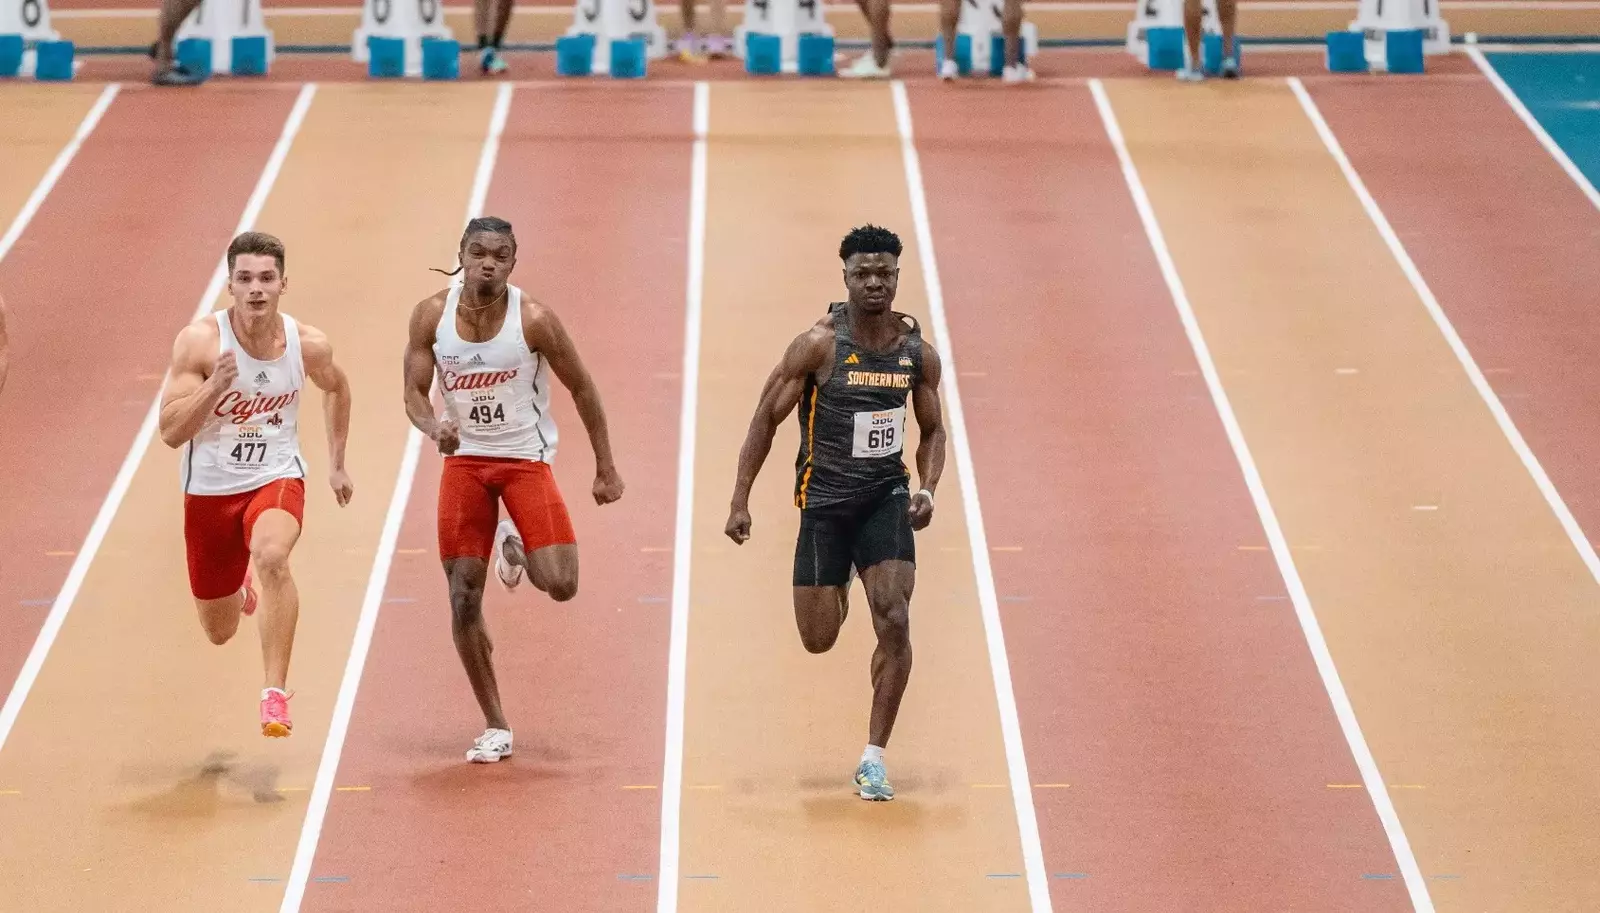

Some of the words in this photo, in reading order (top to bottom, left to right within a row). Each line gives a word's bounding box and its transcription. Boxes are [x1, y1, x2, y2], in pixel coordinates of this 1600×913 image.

[847, 371, 892, 387] SOUTHERN
[892, 374, 910, 388] MISS
[214, 389, 298, 424] Cajuns
[469, 403, 505, 423] 494
[868, 427, 894, 448] 619
[230, 442, 268, 462] 477
